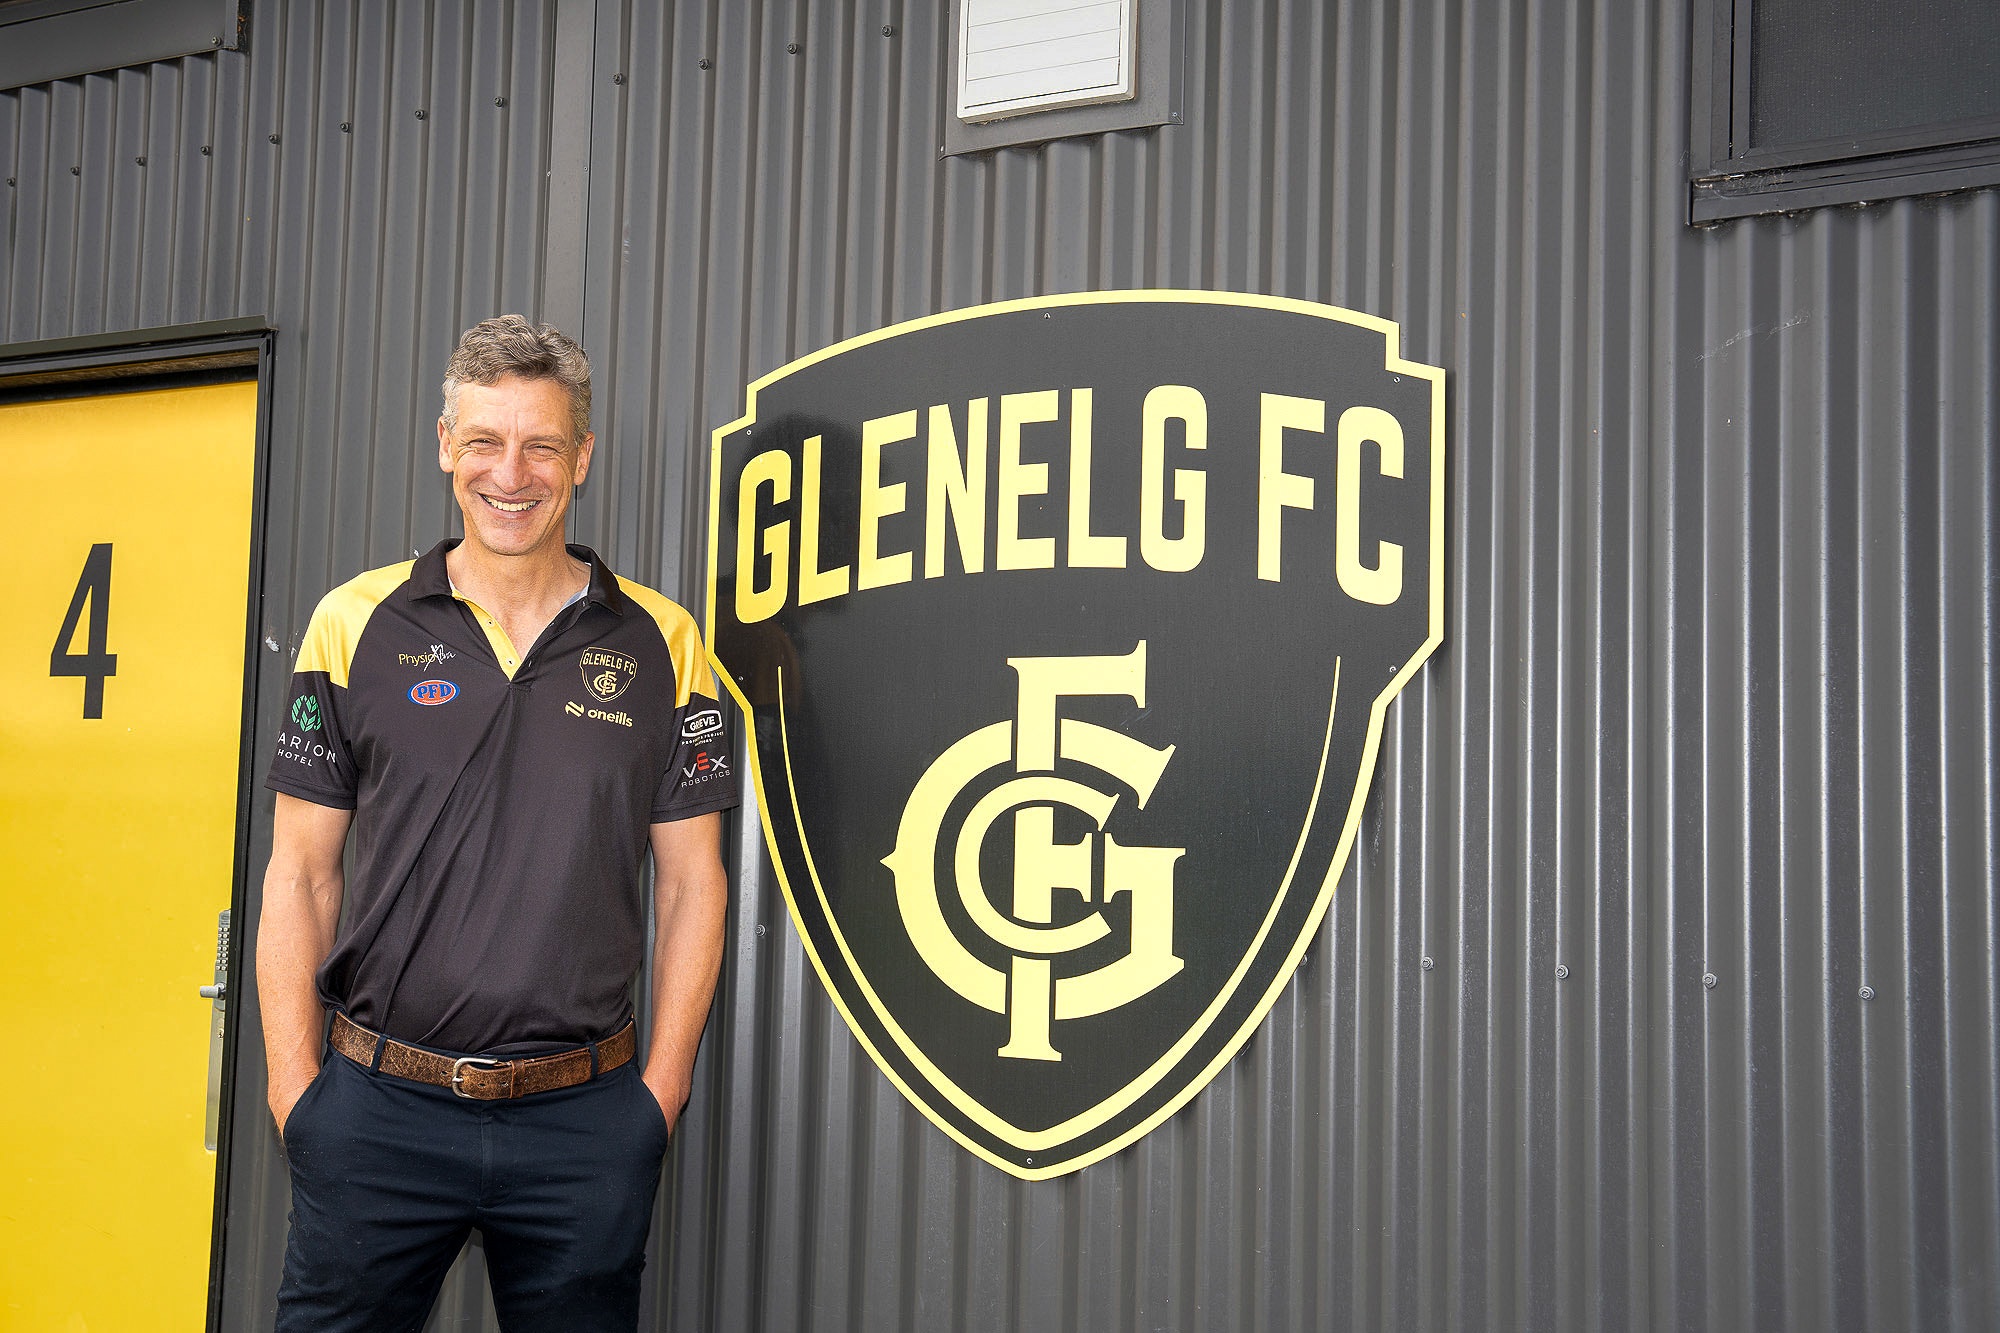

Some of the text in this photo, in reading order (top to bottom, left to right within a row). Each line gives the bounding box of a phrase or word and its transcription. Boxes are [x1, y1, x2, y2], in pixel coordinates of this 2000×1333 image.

[735, 384, 1404, 624] GLENELG FC
[50, 543, 117, 719] 4
[582, 652, 636, 675] GLENELG FC
[417, 684, 452, 699] PFD
[277, 748, 313, 767] HOTEL
[681, 770, 731, 788] ROBOTICS
